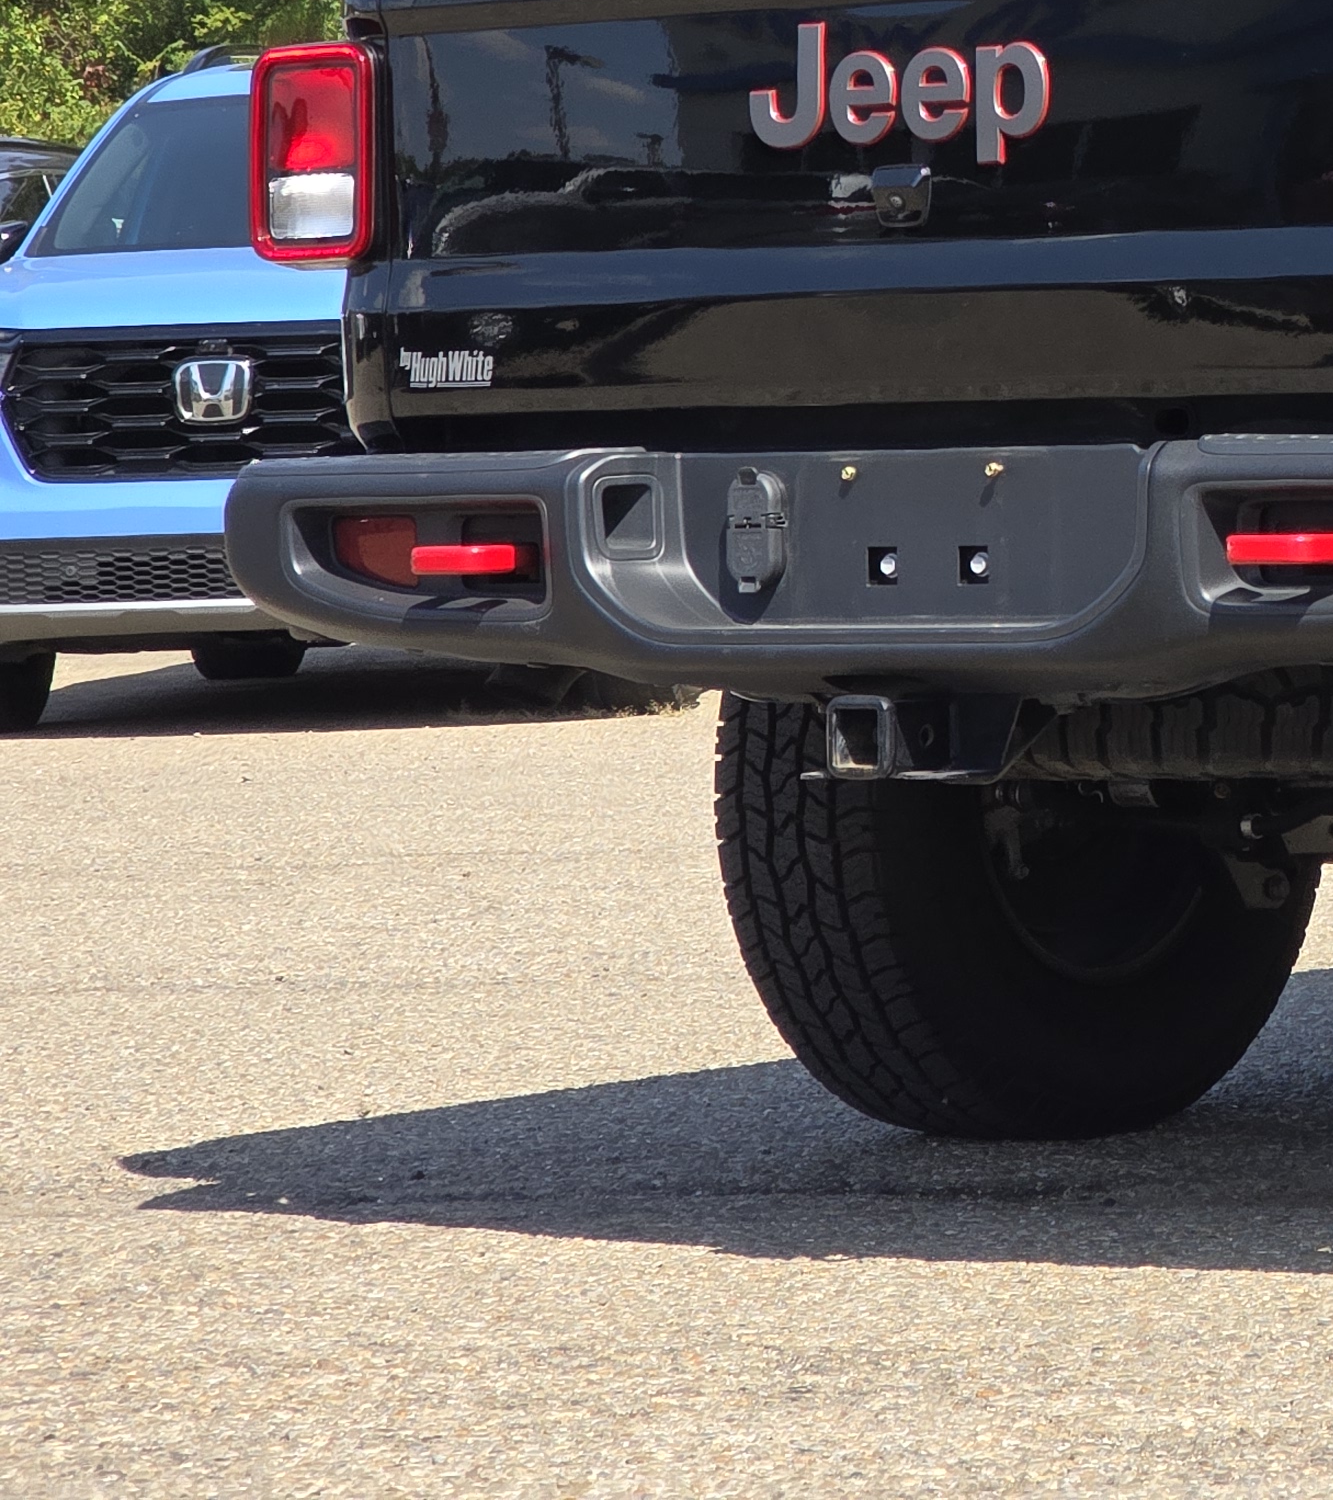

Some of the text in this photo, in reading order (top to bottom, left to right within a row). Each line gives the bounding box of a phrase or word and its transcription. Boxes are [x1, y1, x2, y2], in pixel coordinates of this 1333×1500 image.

[749, 20, 1050, 165] Jeep
[400, 347, 493, 388] by Hugh White
